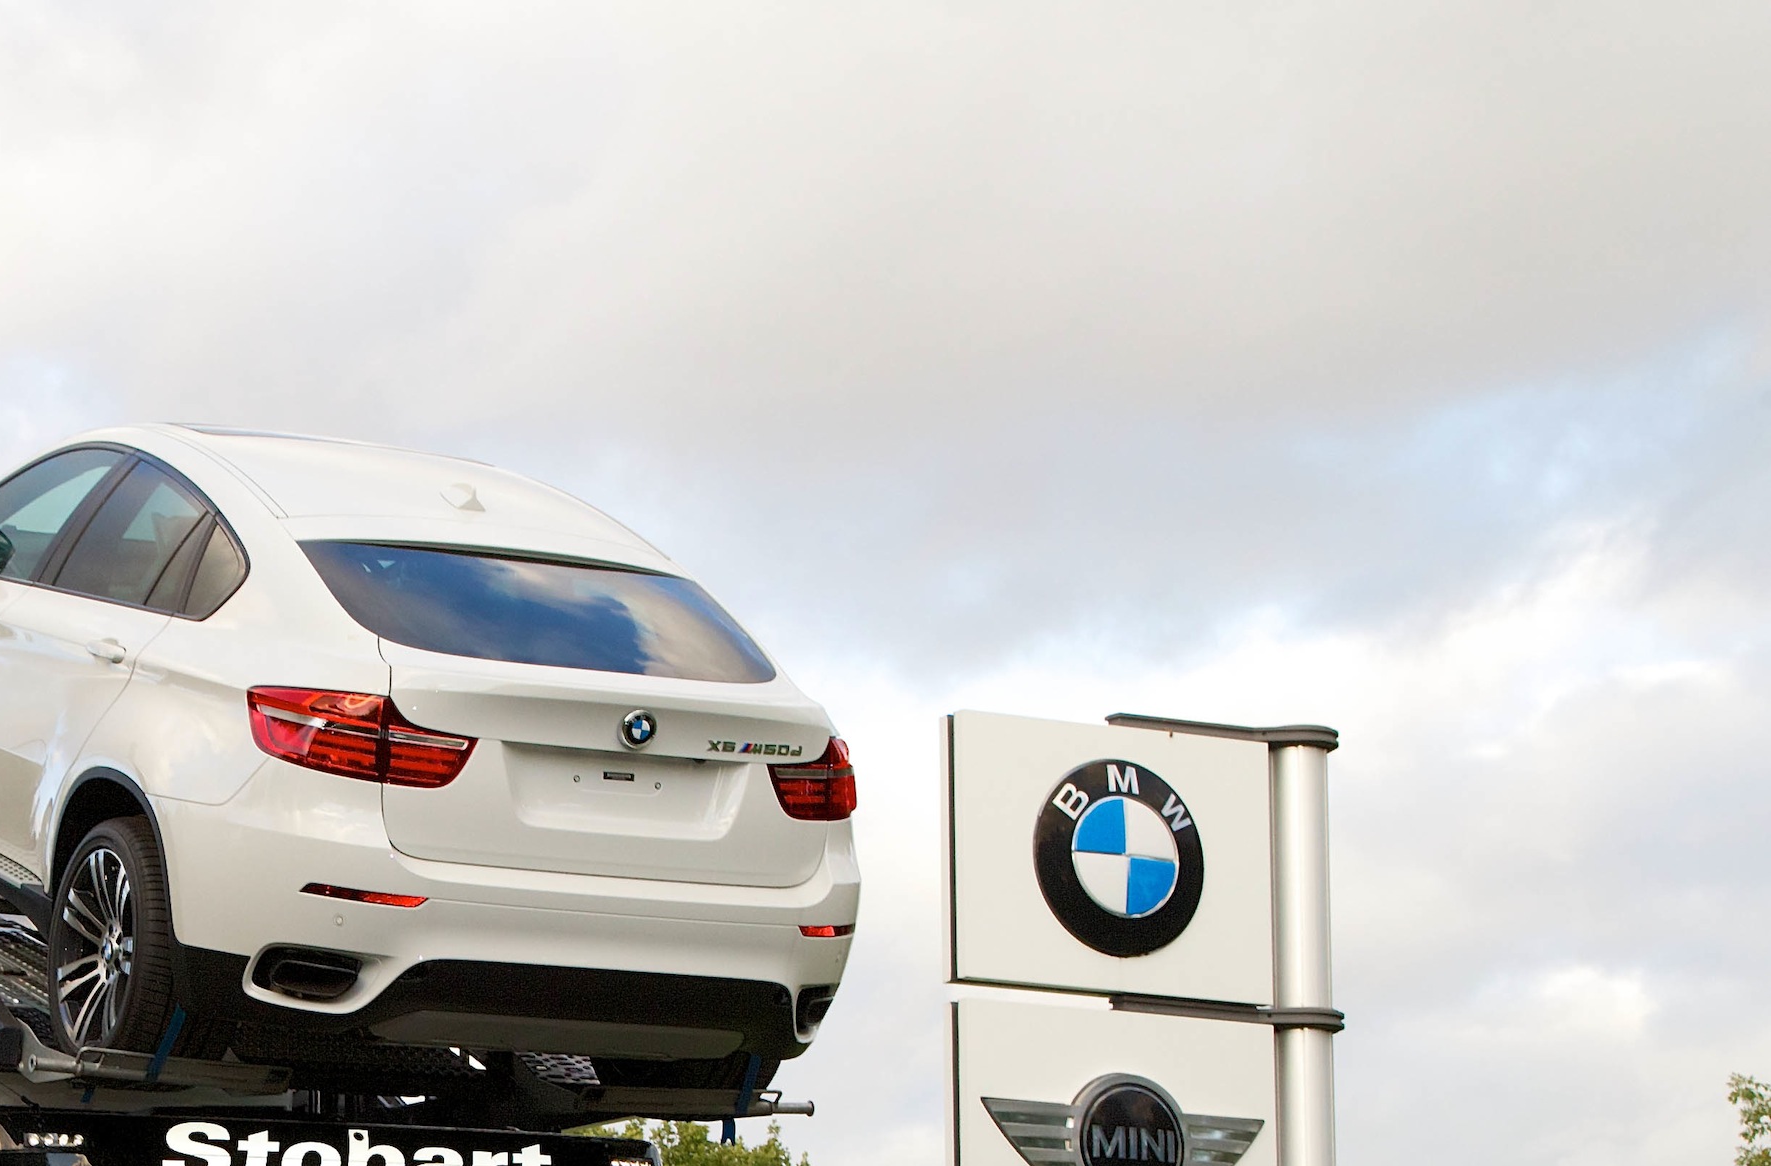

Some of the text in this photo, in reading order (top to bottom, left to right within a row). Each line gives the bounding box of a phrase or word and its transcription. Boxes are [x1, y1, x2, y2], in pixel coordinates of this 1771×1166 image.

[707, 740, 736, 753] X6
[1052, 764, 1192, 832] BMW
[1091, 1124, 1176, 1164] MINI
